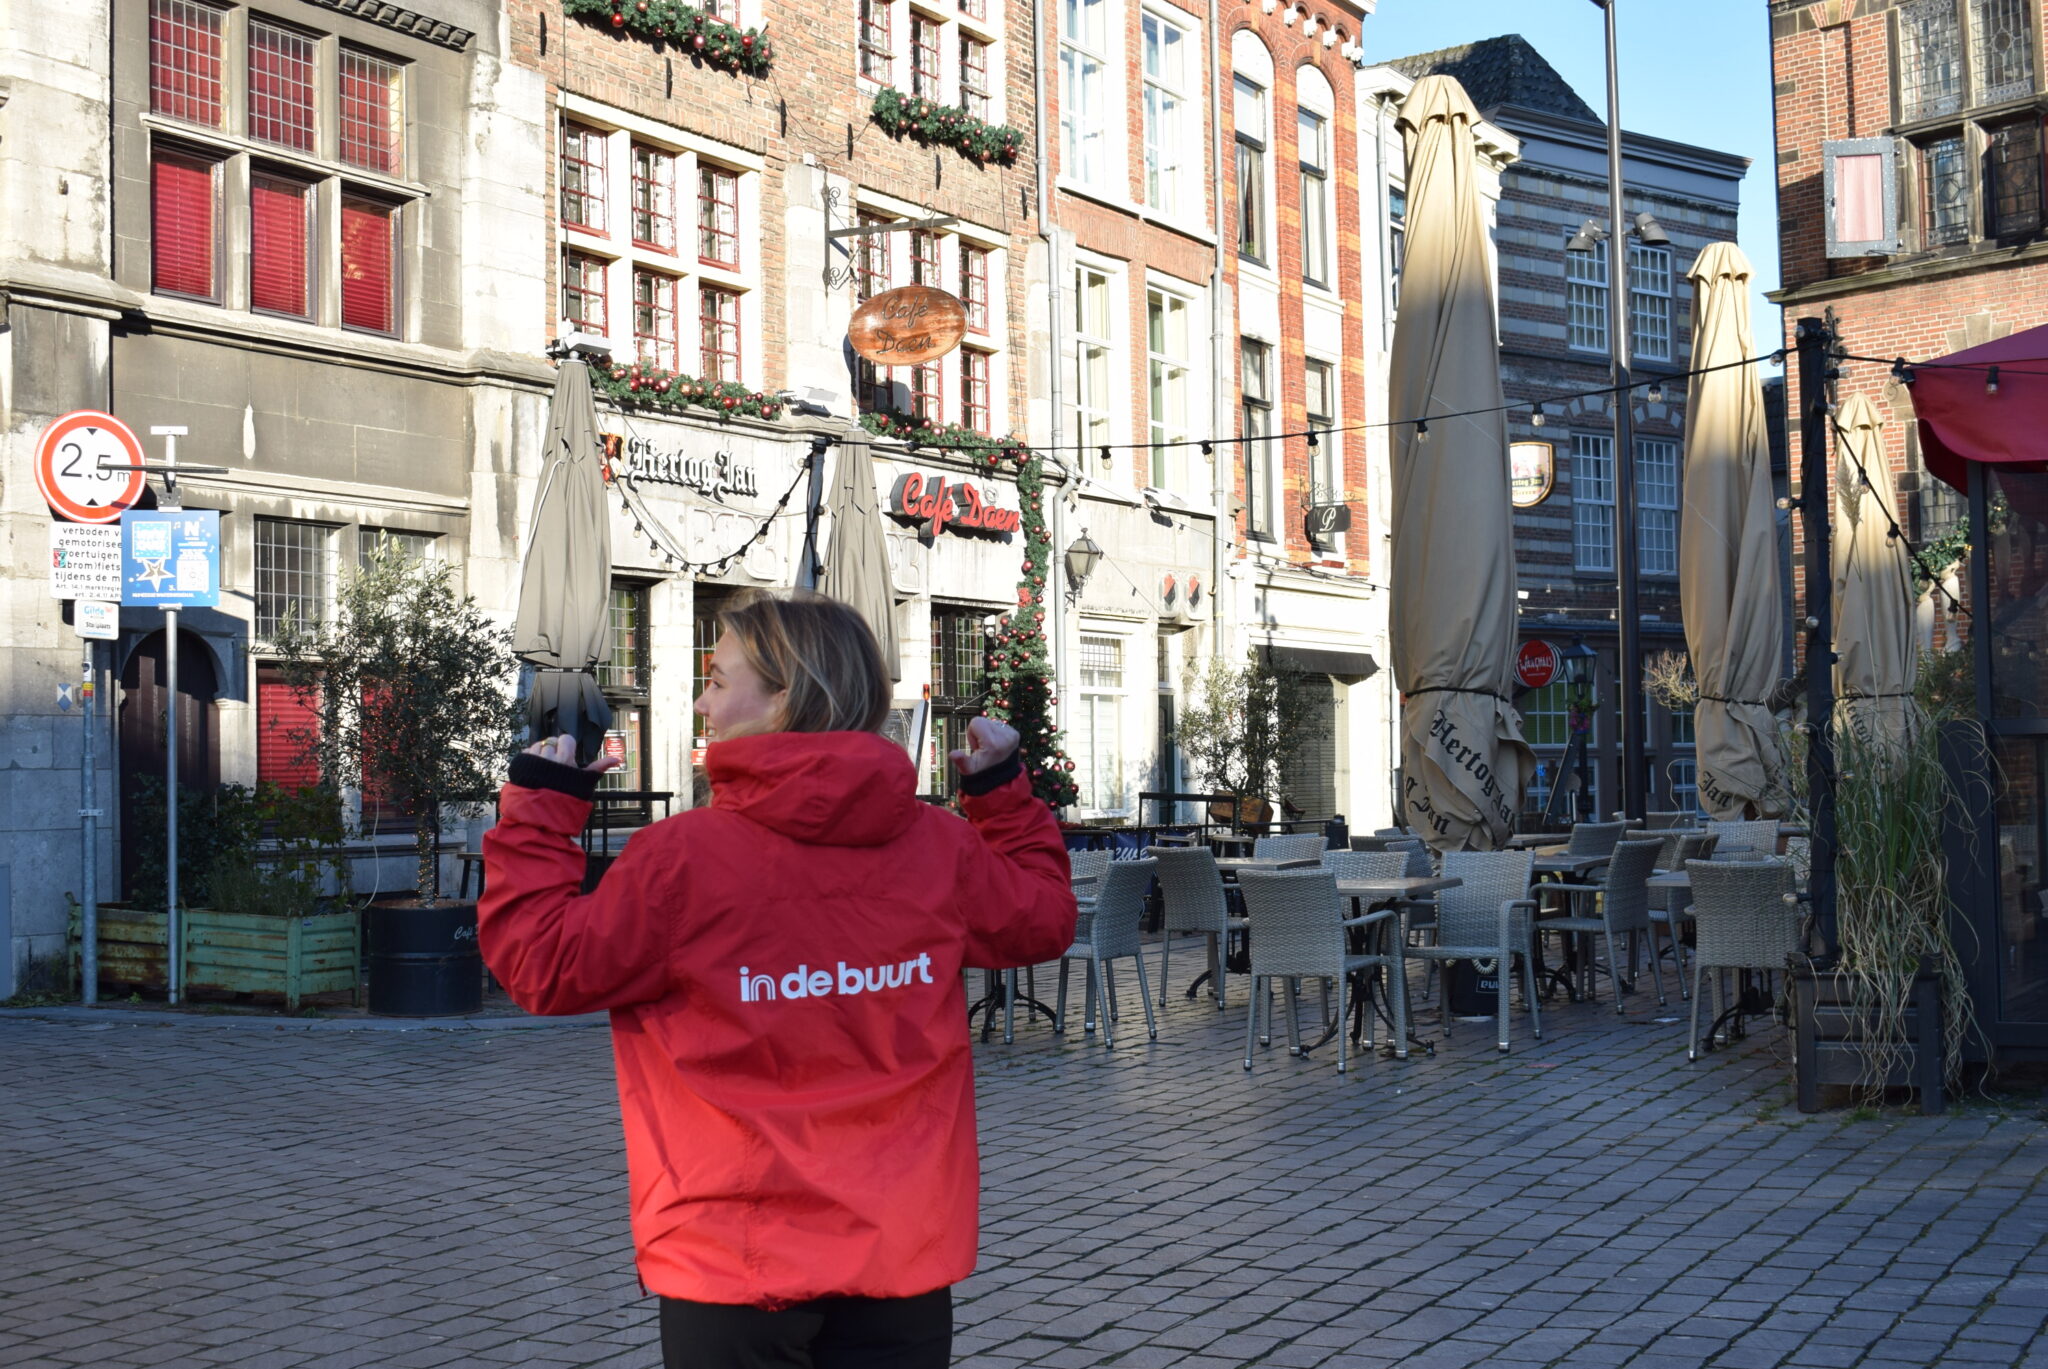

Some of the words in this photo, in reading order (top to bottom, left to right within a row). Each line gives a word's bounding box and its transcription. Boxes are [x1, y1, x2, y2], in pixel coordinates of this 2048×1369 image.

[876, 329, 936, 354] Daen
[627, 436, 719, 494] Hertog
[713, 450, 758, 502] Jan
[901, 472, 953, 536] Café
[960, 482, 1020, 533] Daen
[58, 538, 122, 549] gemotorisee
[62, 527, 110, 537] verboden
[55, 572, 92, 583] tijdens
[95, 574, 107, 582] de
[1430, 709, 1498, 798] Hertog
[1697, 770, 1730, 808] Jan
